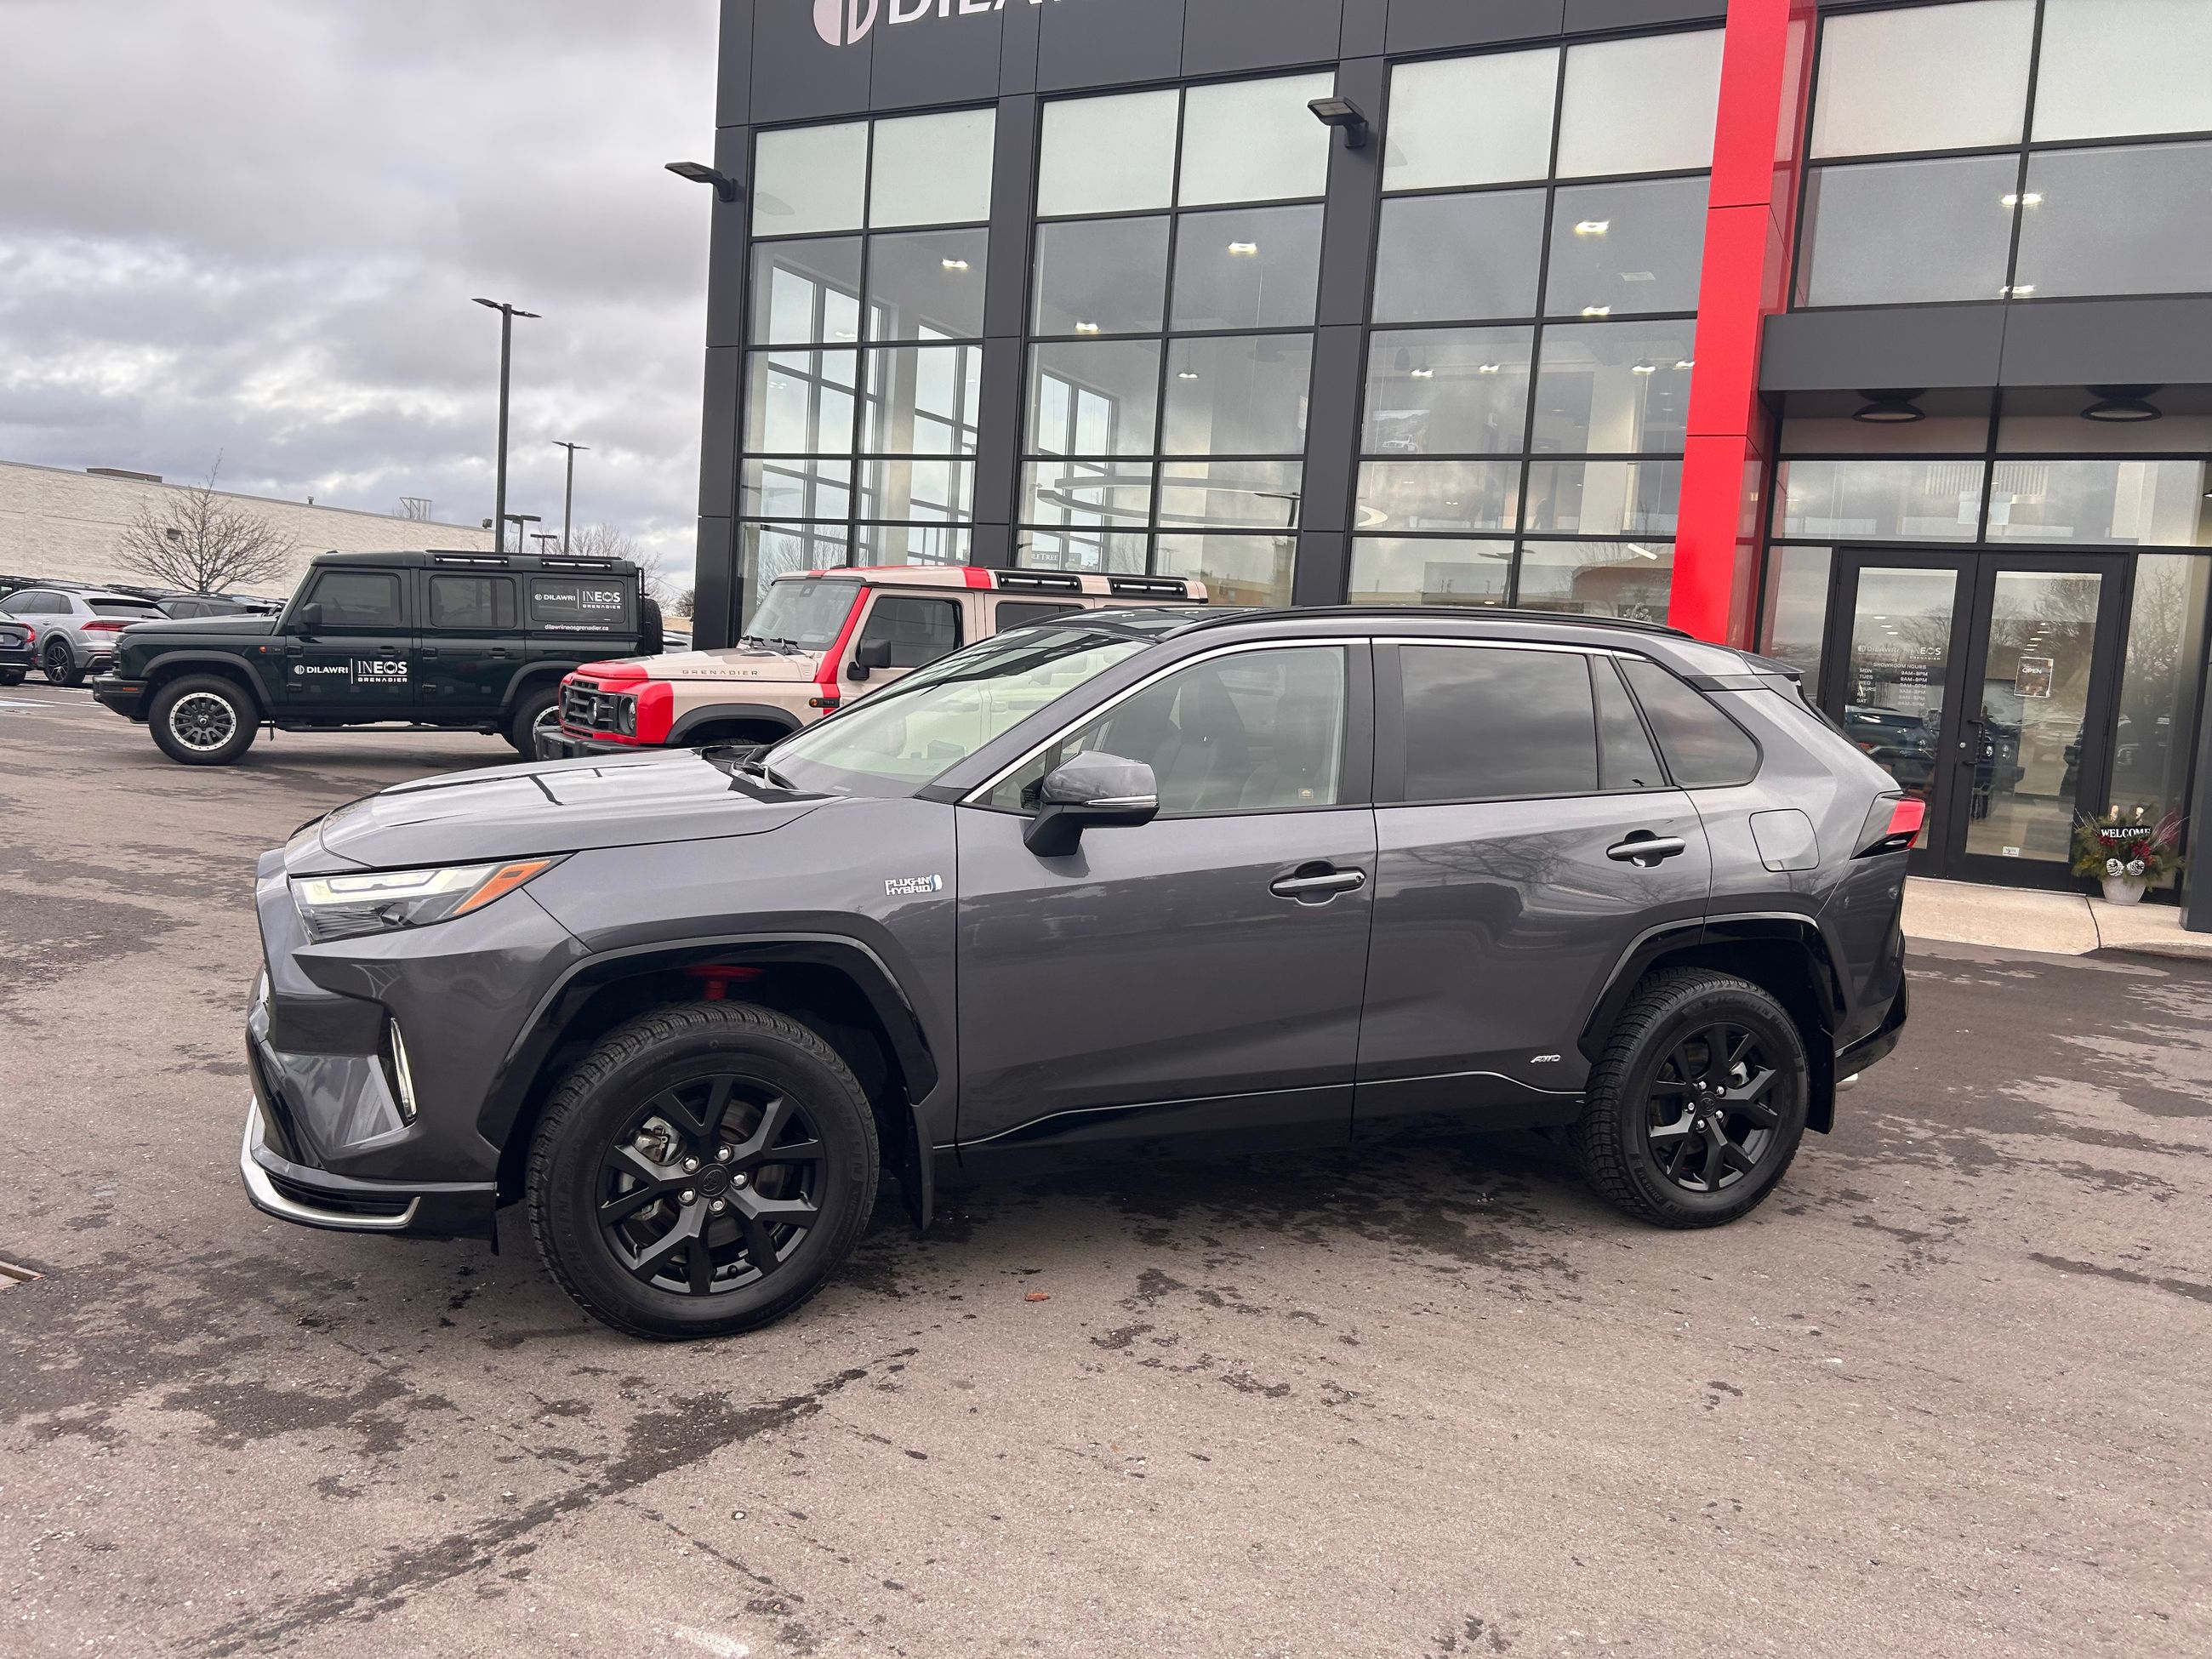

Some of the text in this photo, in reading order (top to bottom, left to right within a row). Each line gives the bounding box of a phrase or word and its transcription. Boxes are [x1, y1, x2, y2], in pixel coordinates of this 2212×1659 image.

[582, 590, 621, 602] INEOS
[357, 661, 408, 675] INEOS
[2101, 828, 2151, 838] WELCOME
[885, 877, 930, 887] PLUG-IN
[886, 885, 932, 896] HYBRID
[1531, 1054, 1561, 1063] AWD
